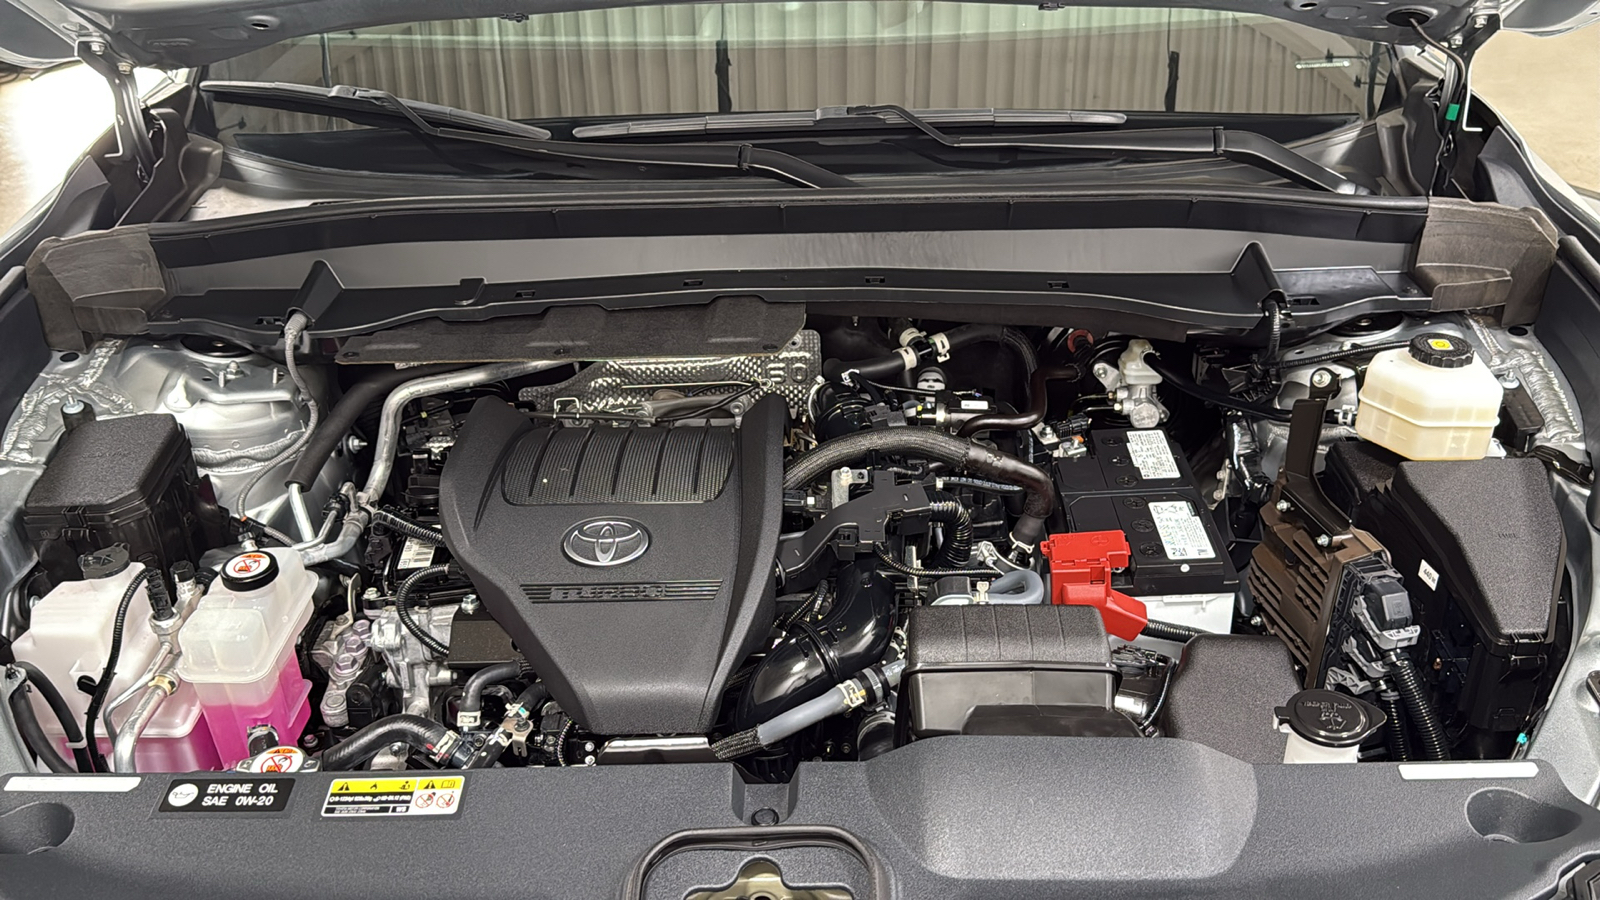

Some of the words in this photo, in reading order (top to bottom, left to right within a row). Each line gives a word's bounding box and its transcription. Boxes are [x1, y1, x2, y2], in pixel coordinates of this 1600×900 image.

[207, 783, 253, 793] ENGINE
[258, 783, 278, 793] OIL
[201, 796, 229, 806] SAE
[235, 795, 274, 806] 0W-20
